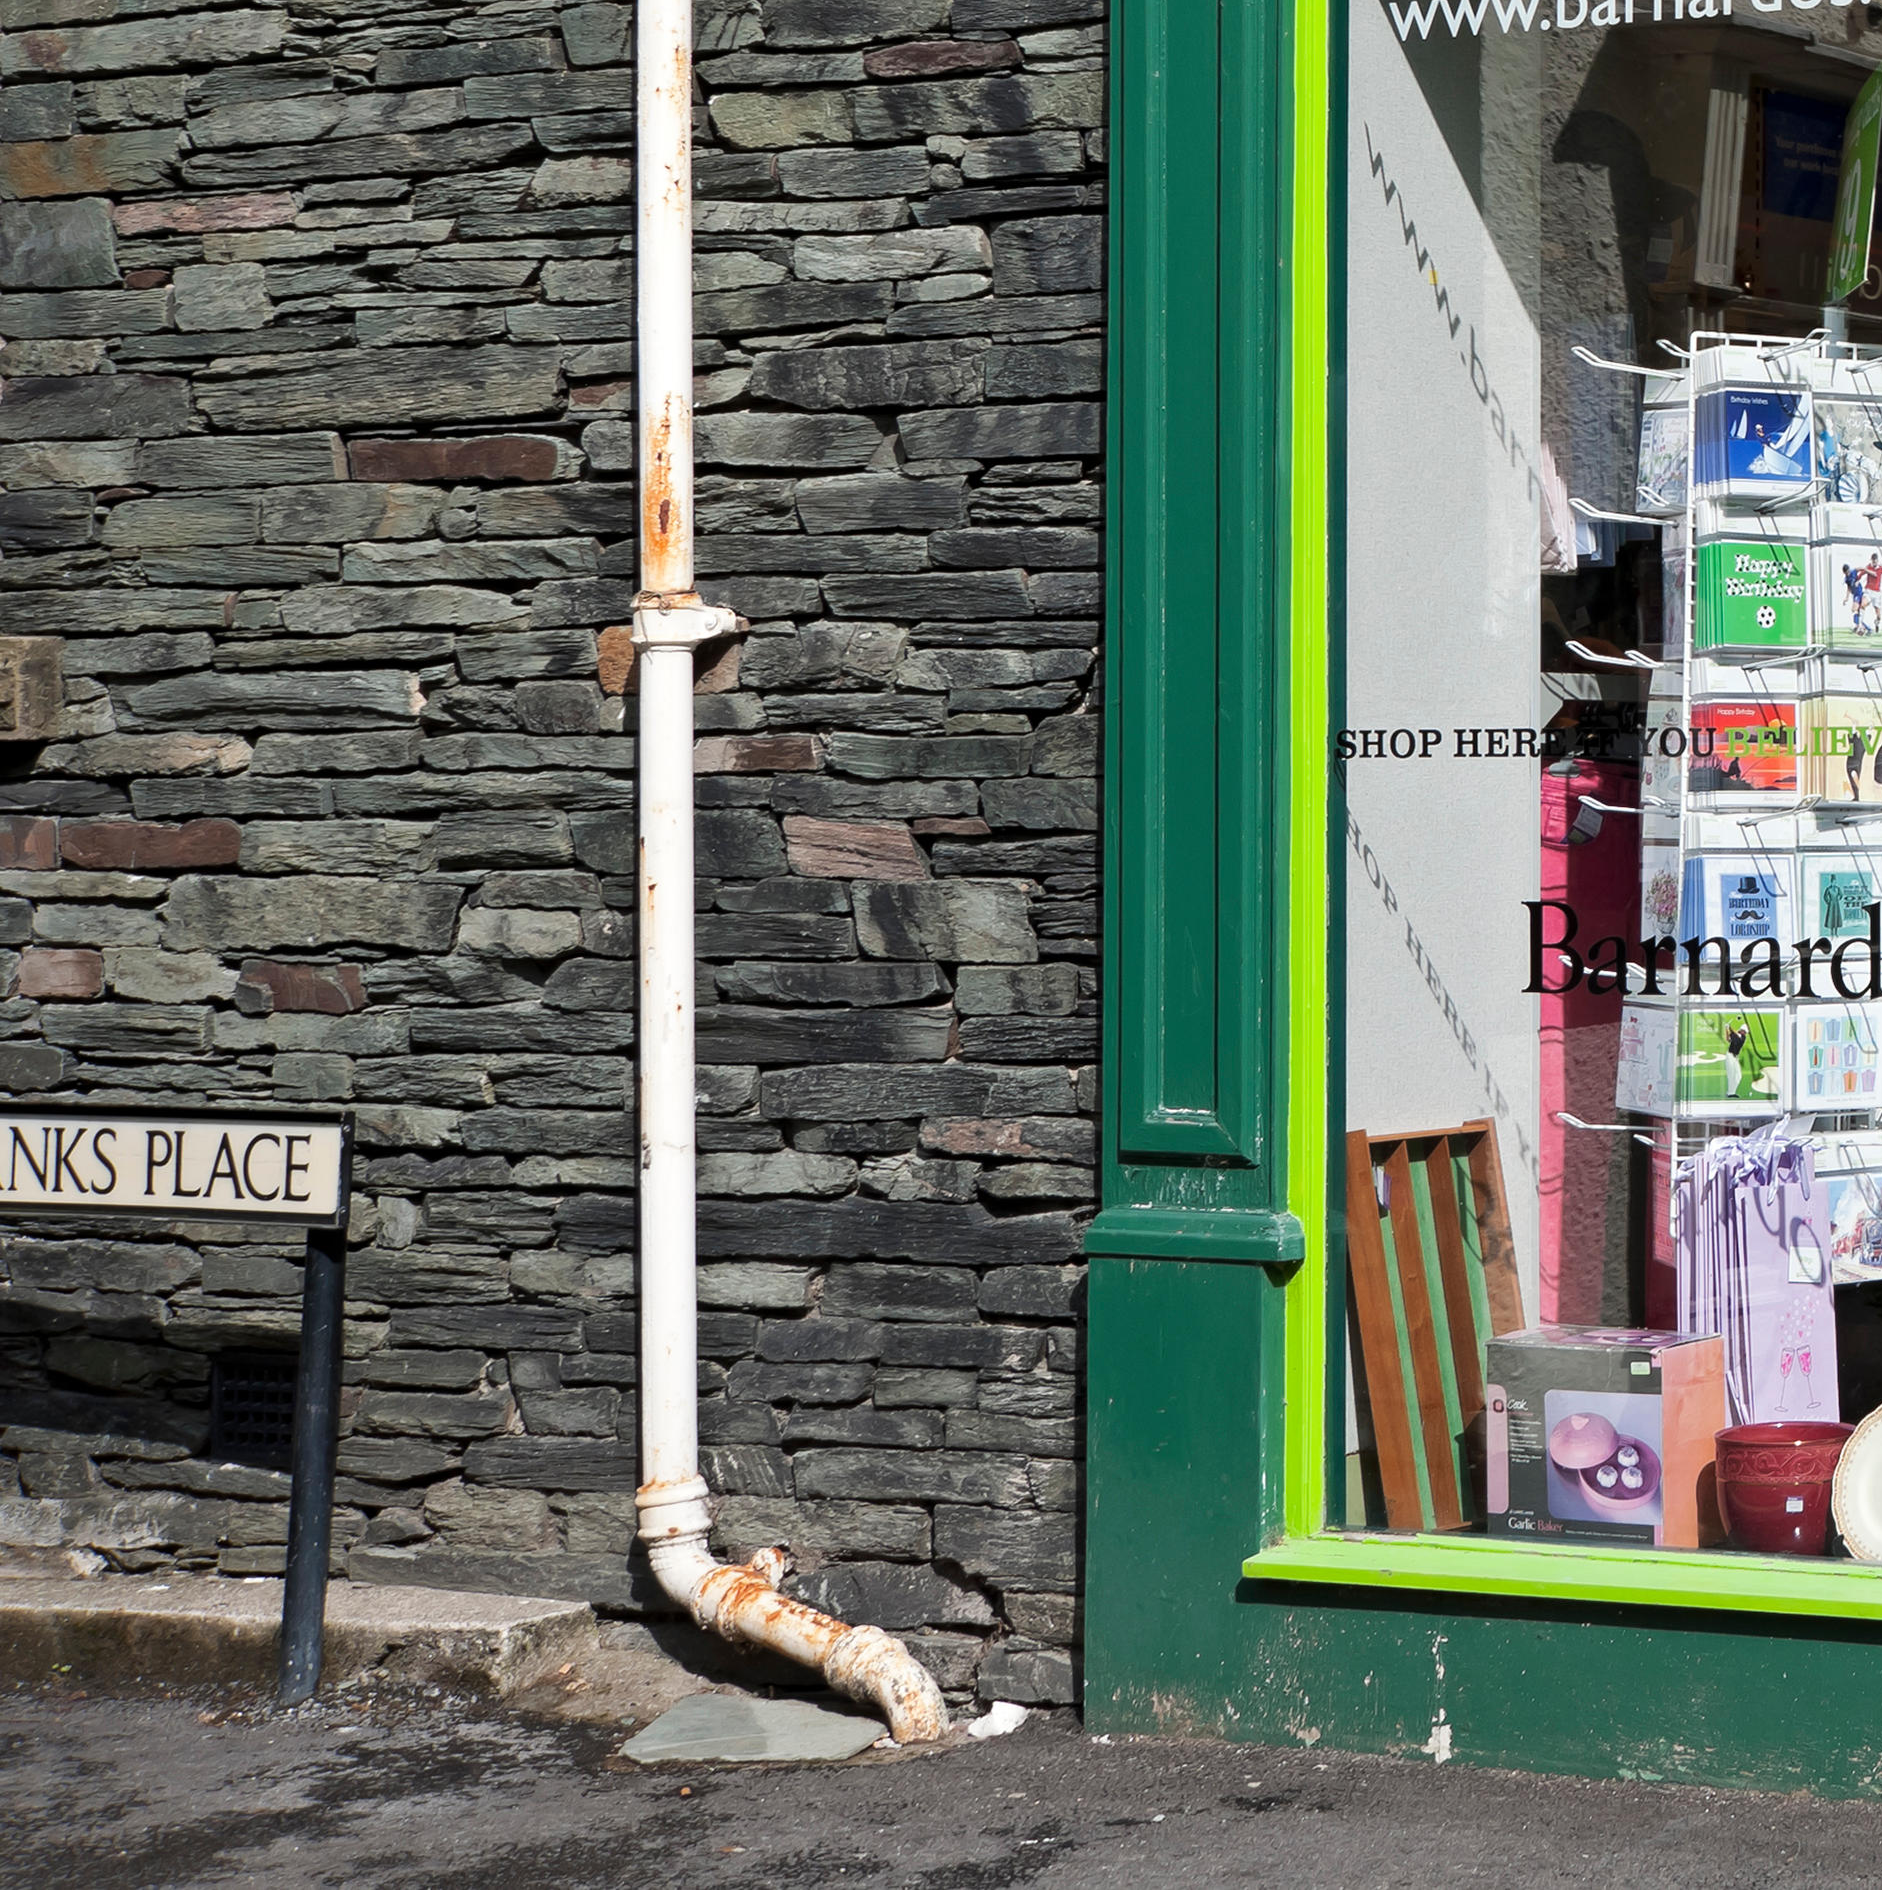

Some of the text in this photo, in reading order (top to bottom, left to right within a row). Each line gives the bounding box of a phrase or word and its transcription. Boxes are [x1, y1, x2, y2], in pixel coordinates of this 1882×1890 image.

[1734, 553, 1795, 579] Happy
[1725, 577, 1805, 603] Birthday
[1335, 727, 1444, 761] SHOP
[1454, 726, 1567, 760] HERE
[1636, 726, 1718, 758] YOU
[0, 1125, 313, 1202] NKS PLACE
[1507, 1515, 1564, 1533] Garlic Baker
